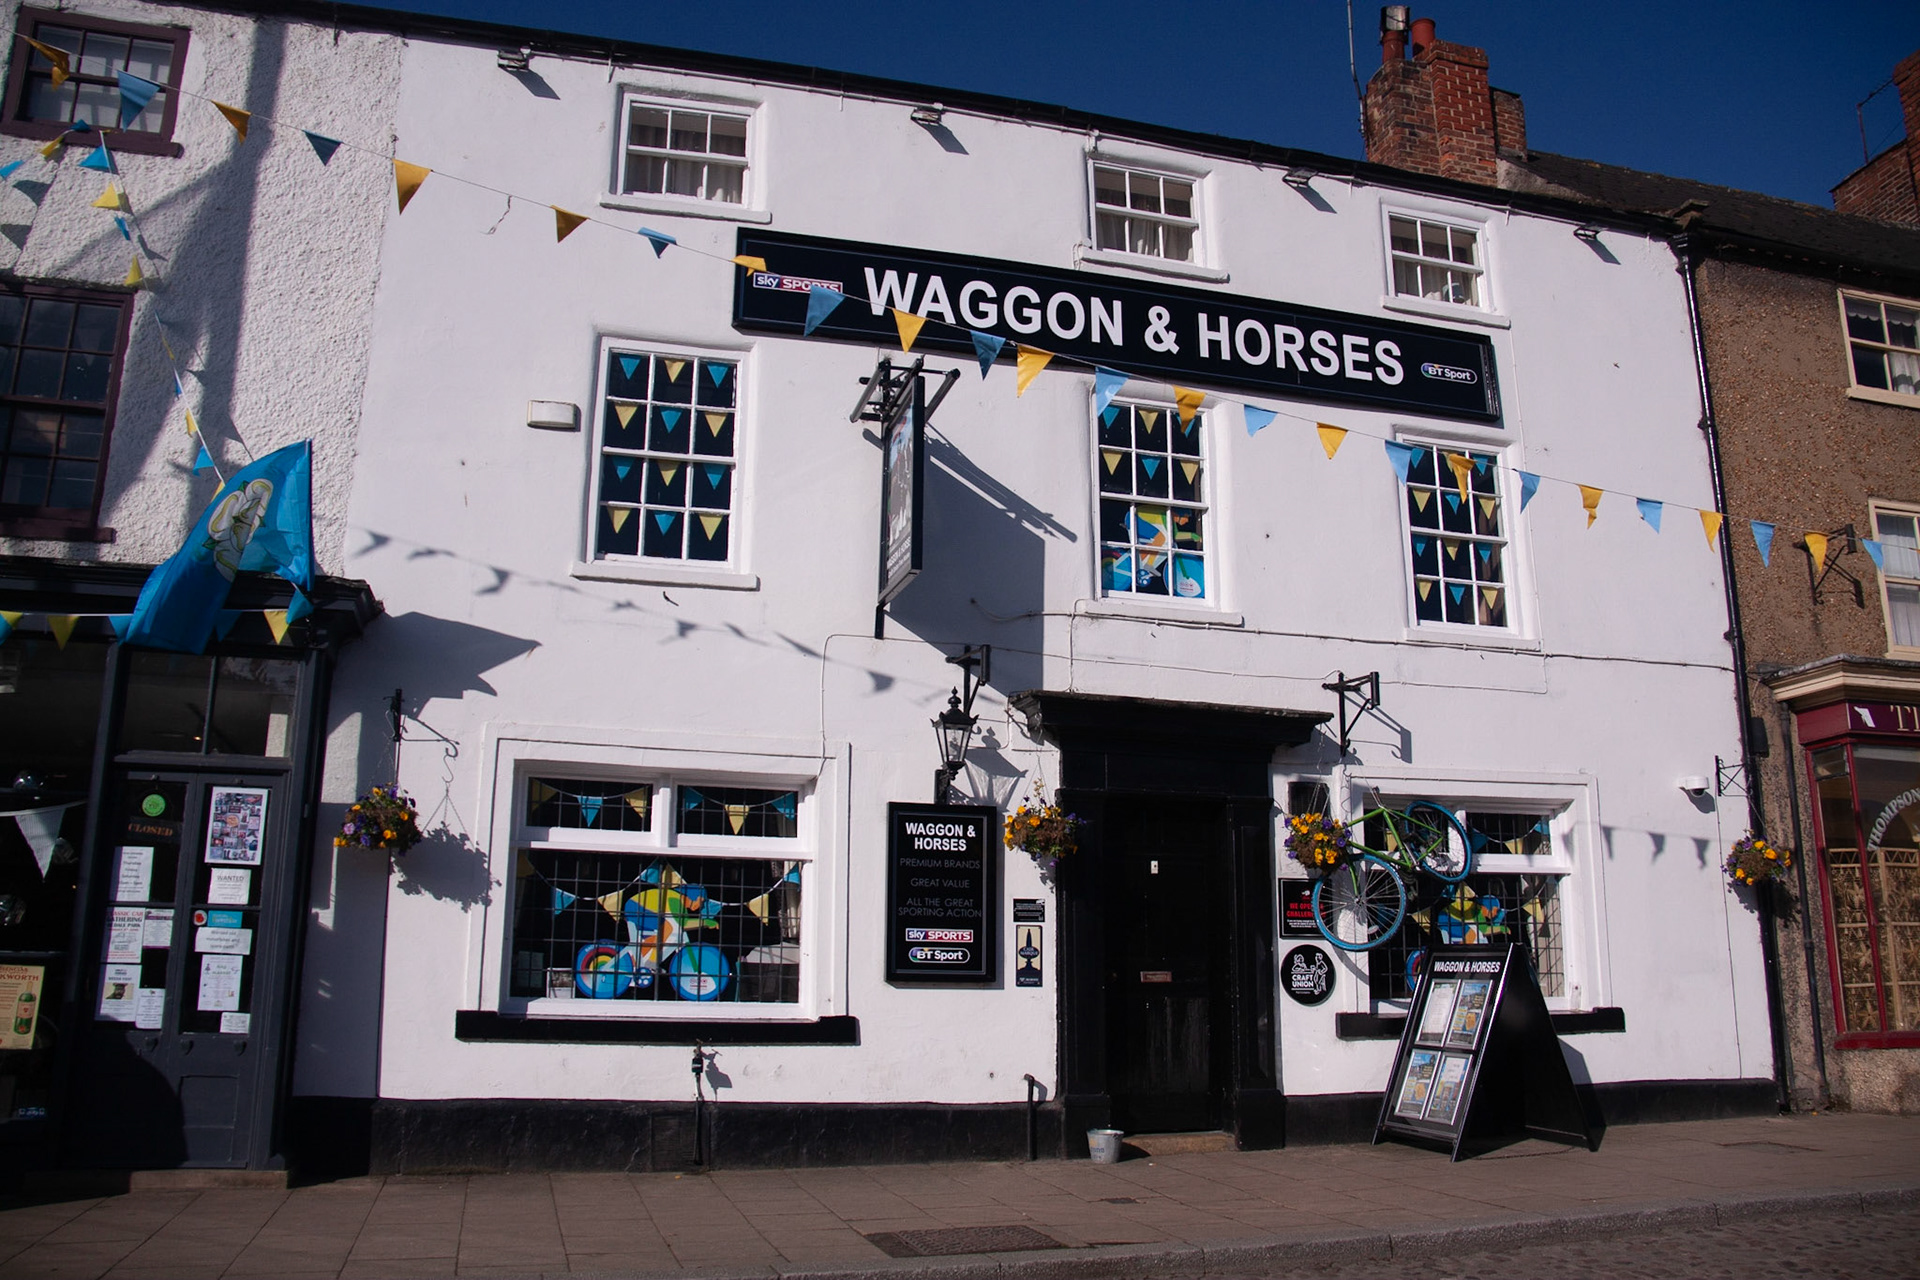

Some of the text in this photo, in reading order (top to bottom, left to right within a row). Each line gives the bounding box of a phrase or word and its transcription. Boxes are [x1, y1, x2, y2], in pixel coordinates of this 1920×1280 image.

[757, 275, 779, 288] sky
[864, 267, 1405, 386] WAGGON & HORSES
[1428, 366, 1471, 380] BT Sport
[128, 823, 173, 836] CLOSED
[905, 822, 976, 838] WAGGON &
[914, 837, 967, 851] HORSES
[900, 858, 980, 869] PREMIUM BRANDS
[910, 878, 970, 889] GREAT VALUE
[906, 897, 974, 907] ALL THE GREAT
[898, 907, 982, 918] SPORTING ACTION
[908, 929, 971, 941] sky SPORTS
[916, 950, 963, 962] BT Sport
[1434, 961, 1500, 973] WAGGON & HORSES
